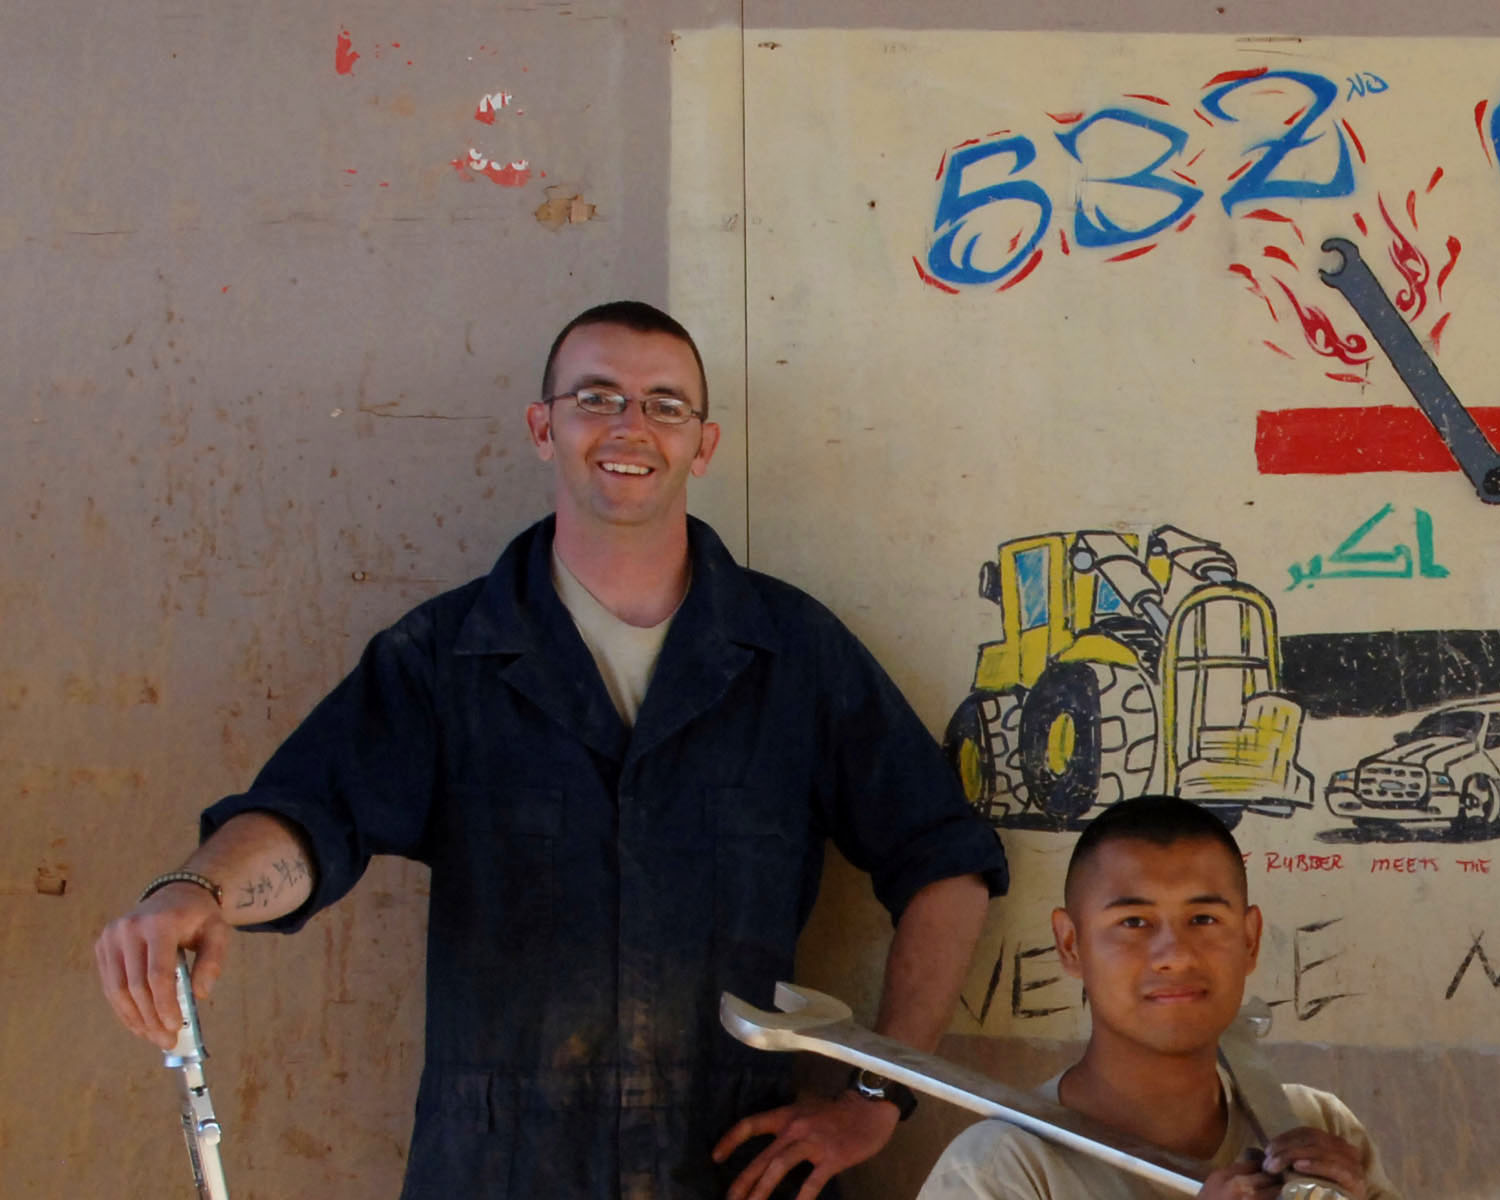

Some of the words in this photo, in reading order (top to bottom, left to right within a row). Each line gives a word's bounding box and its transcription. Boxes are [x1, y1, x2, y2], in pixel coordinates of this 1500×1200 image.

[1264, 851, 1344, 874] RUBBER
[1370, 856, 1439, 874] MEETS
[1455, 858, 1492, 875] THE
